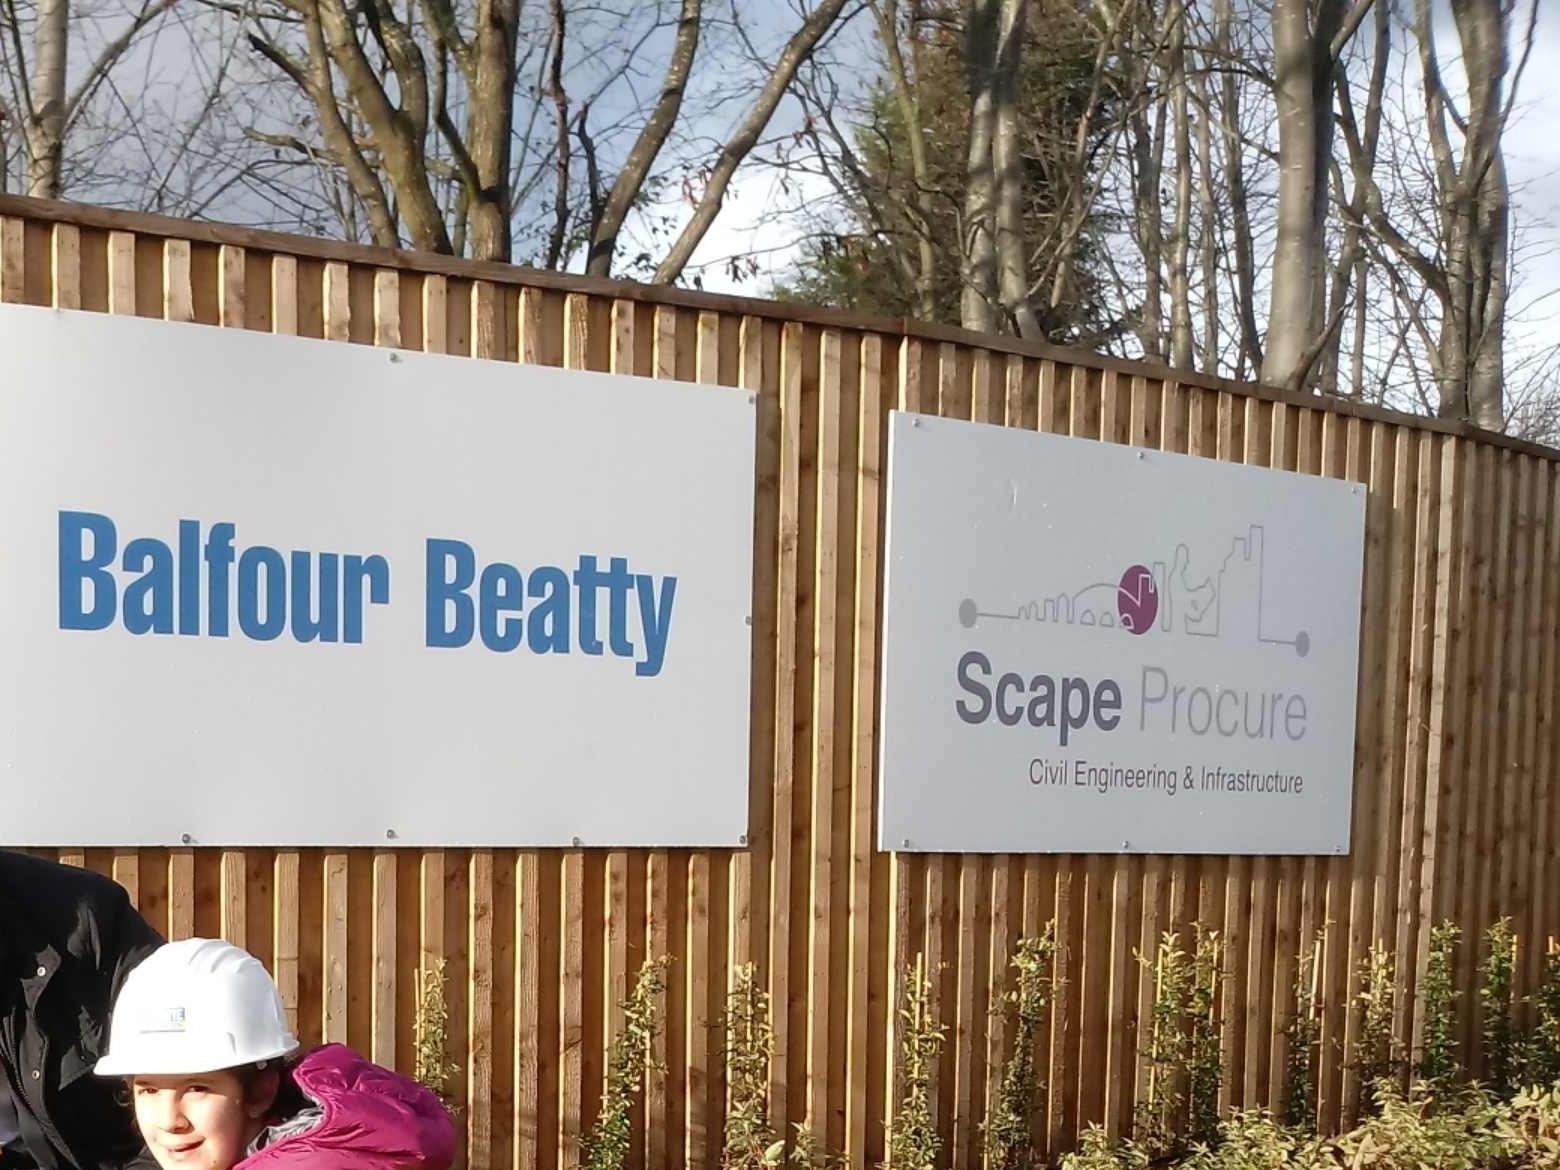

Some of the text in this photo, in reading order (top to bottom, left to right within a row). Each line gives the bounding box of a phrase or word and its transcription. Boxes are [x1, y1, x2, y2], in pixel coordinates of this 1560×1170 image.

[59, 510, 677, 677] Balfour Beatty
[955, 651, 1307, 747] Scape Procure
[1028, 758, 1303, 796] Civil Engineering & Infrastructure
